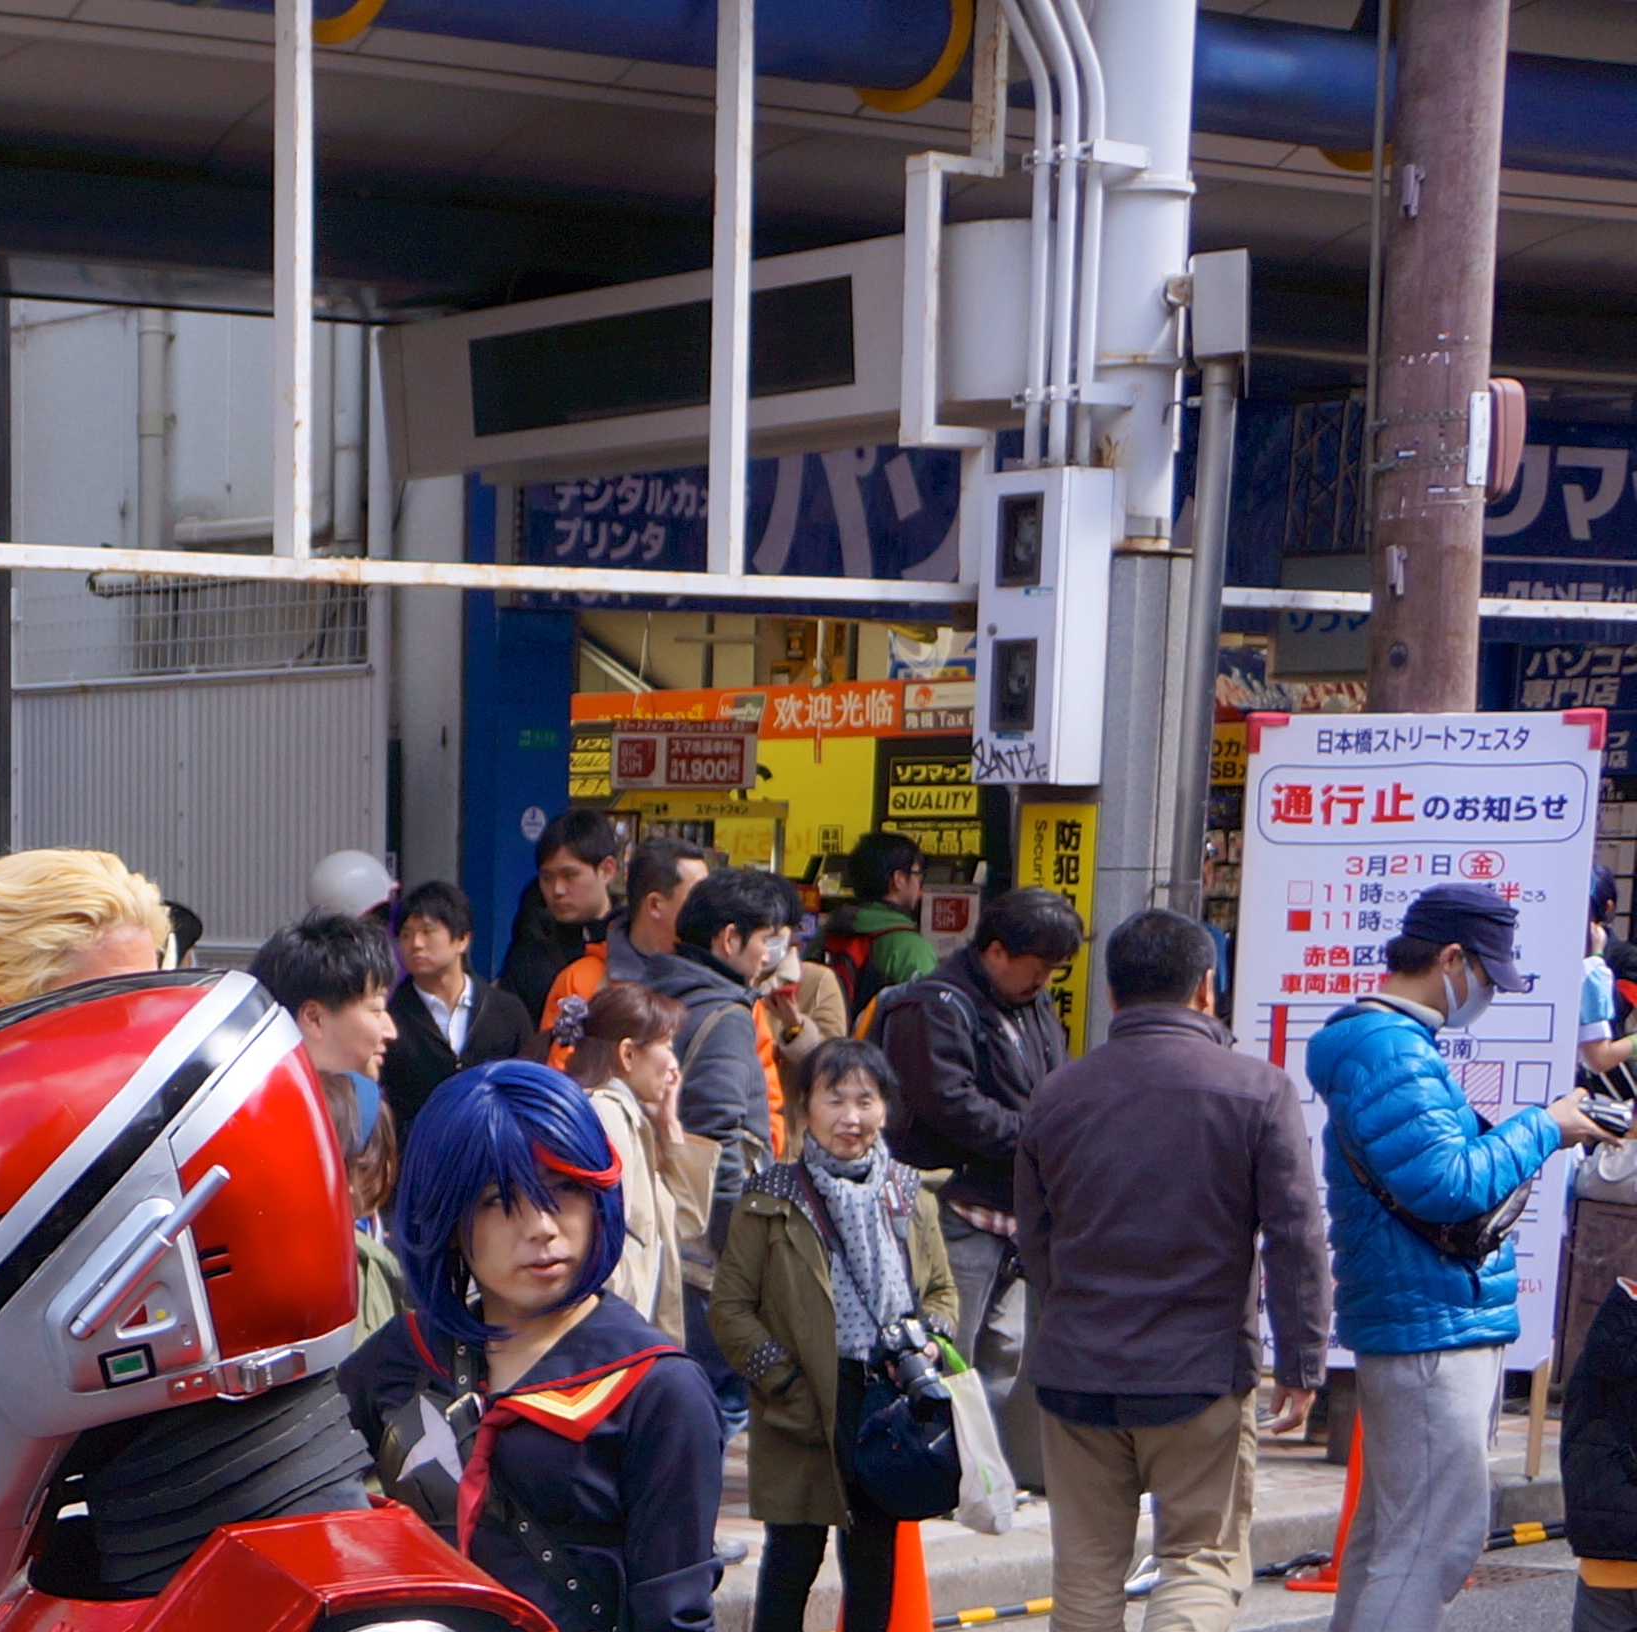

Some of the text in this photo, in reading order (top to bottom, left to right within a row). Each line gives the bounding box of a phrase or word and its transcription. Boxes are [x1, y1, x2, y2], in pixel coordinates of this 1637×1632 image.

[554, 519, 667, 562] プリンタ
[773, 687, 896, 731] 欢迎光临
[1520, 676, 1621, 711] 専門店
[938, 711, 965, 727] Tax
[1316, 724, 1531, 755] 日本橋ストリートフェスタ
[892, 790, 974, 811] QUALITY
[1033, 819, 1048, 889] Securi
